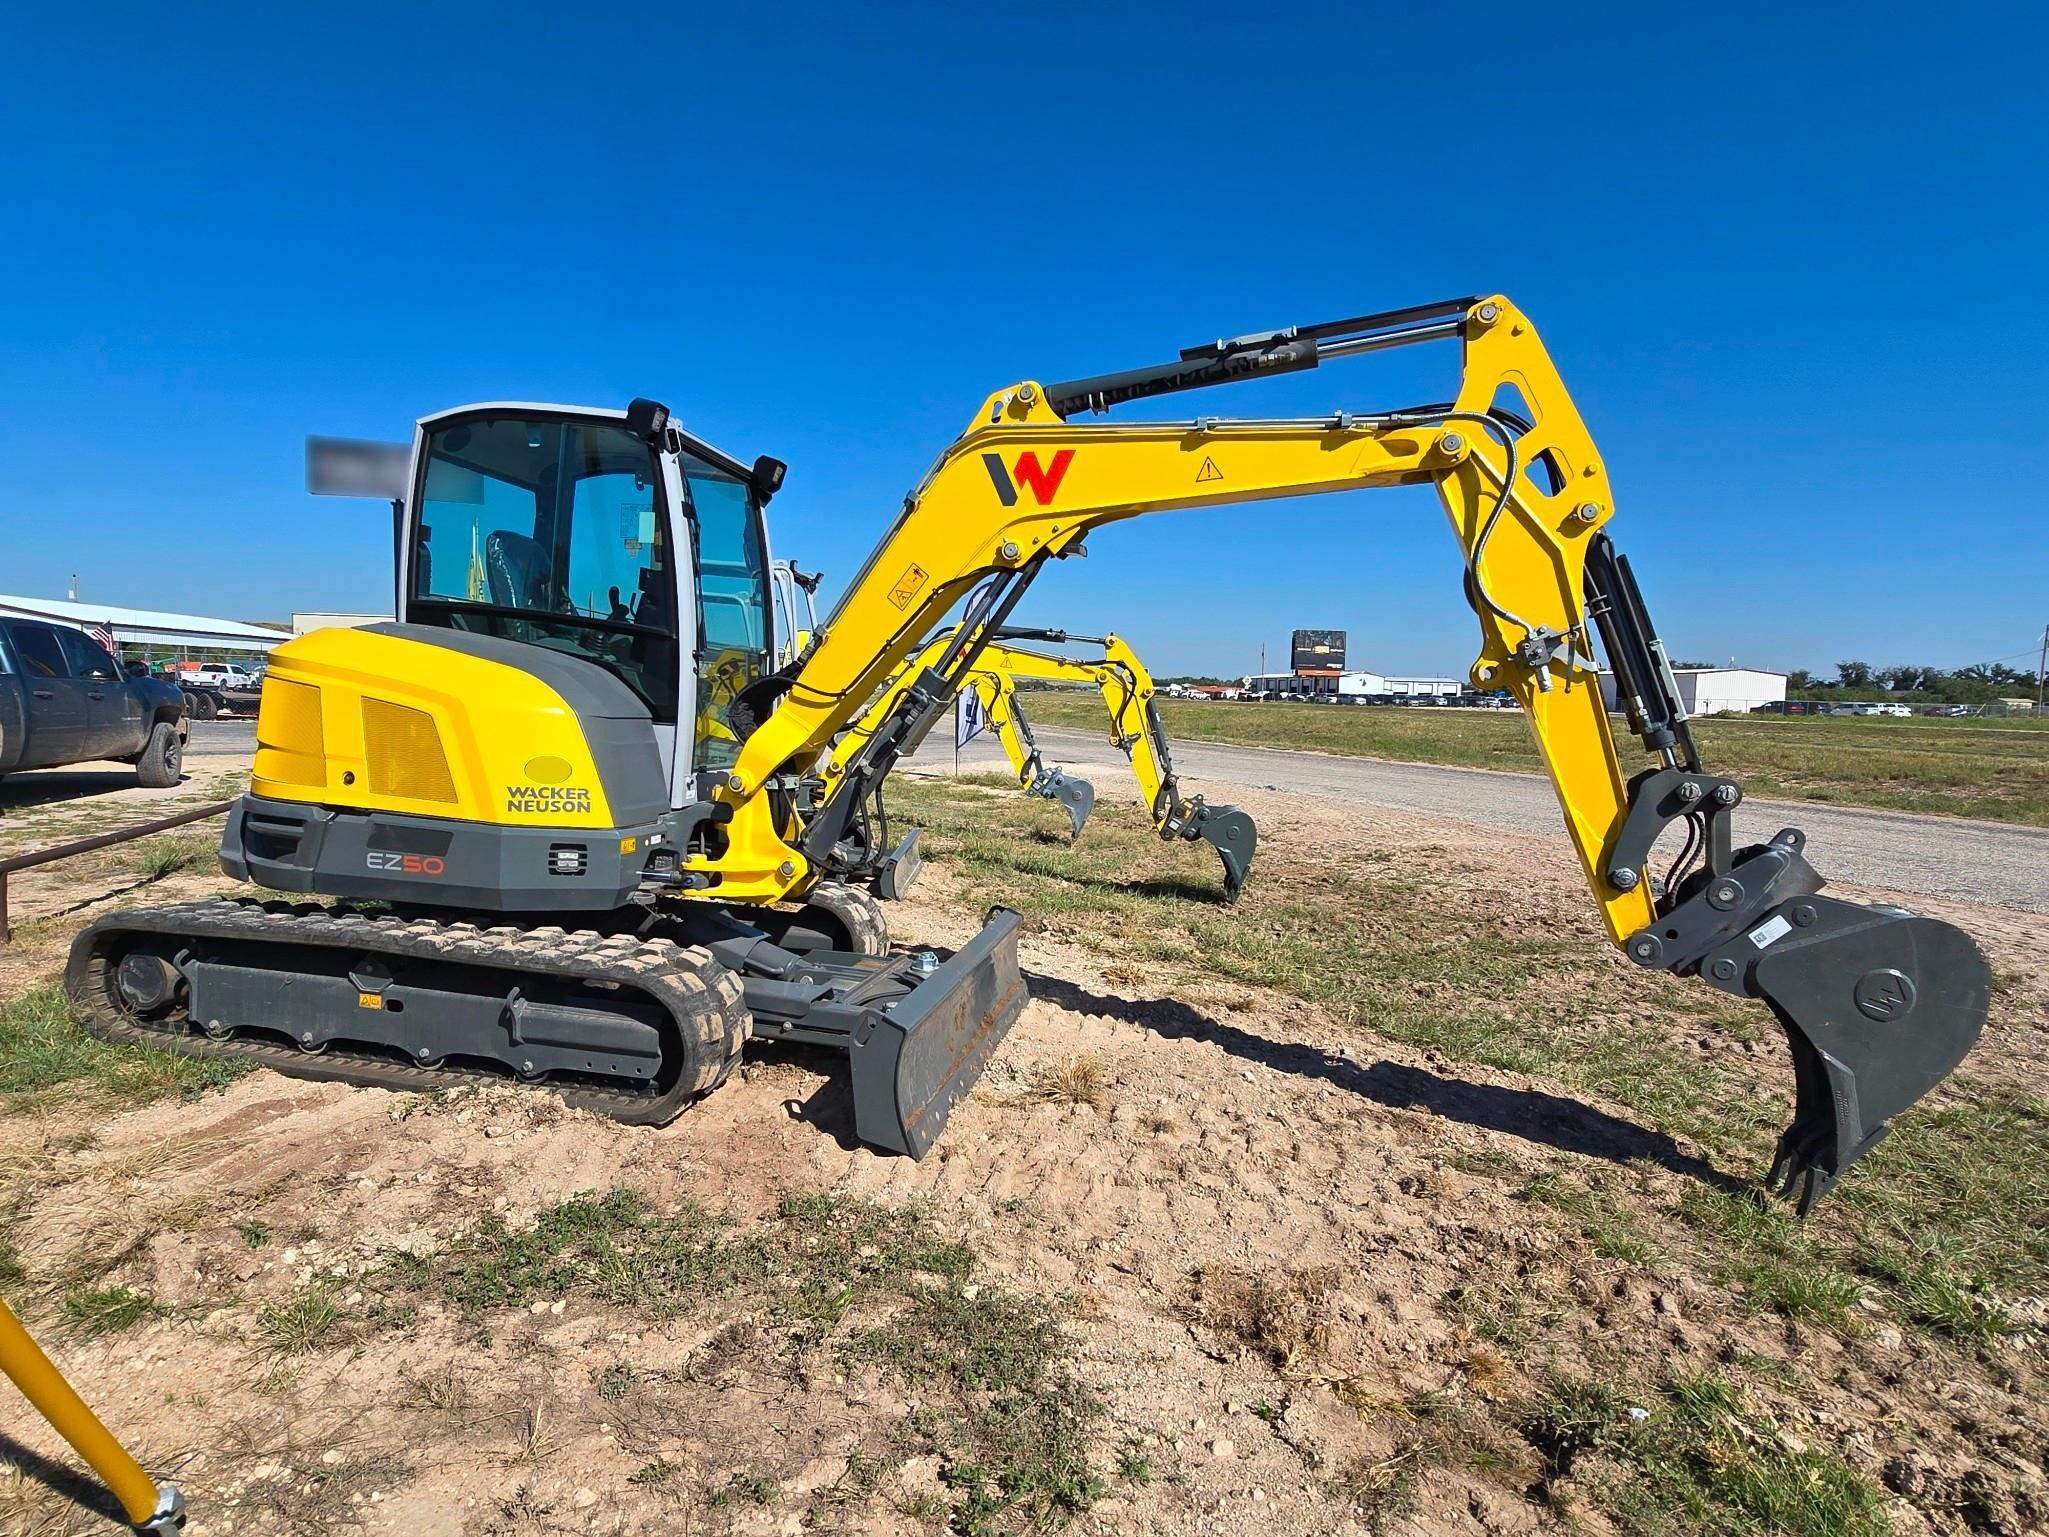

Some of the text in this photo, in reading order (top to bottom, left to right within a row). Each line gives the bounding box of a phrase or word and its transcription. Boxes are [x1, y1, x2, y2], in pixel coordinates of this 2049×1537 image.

[506, 786, 591, 800] WACKER
[507, 800, 591, 813] NEUSON
[366, 852, 445, 875] EZ50
